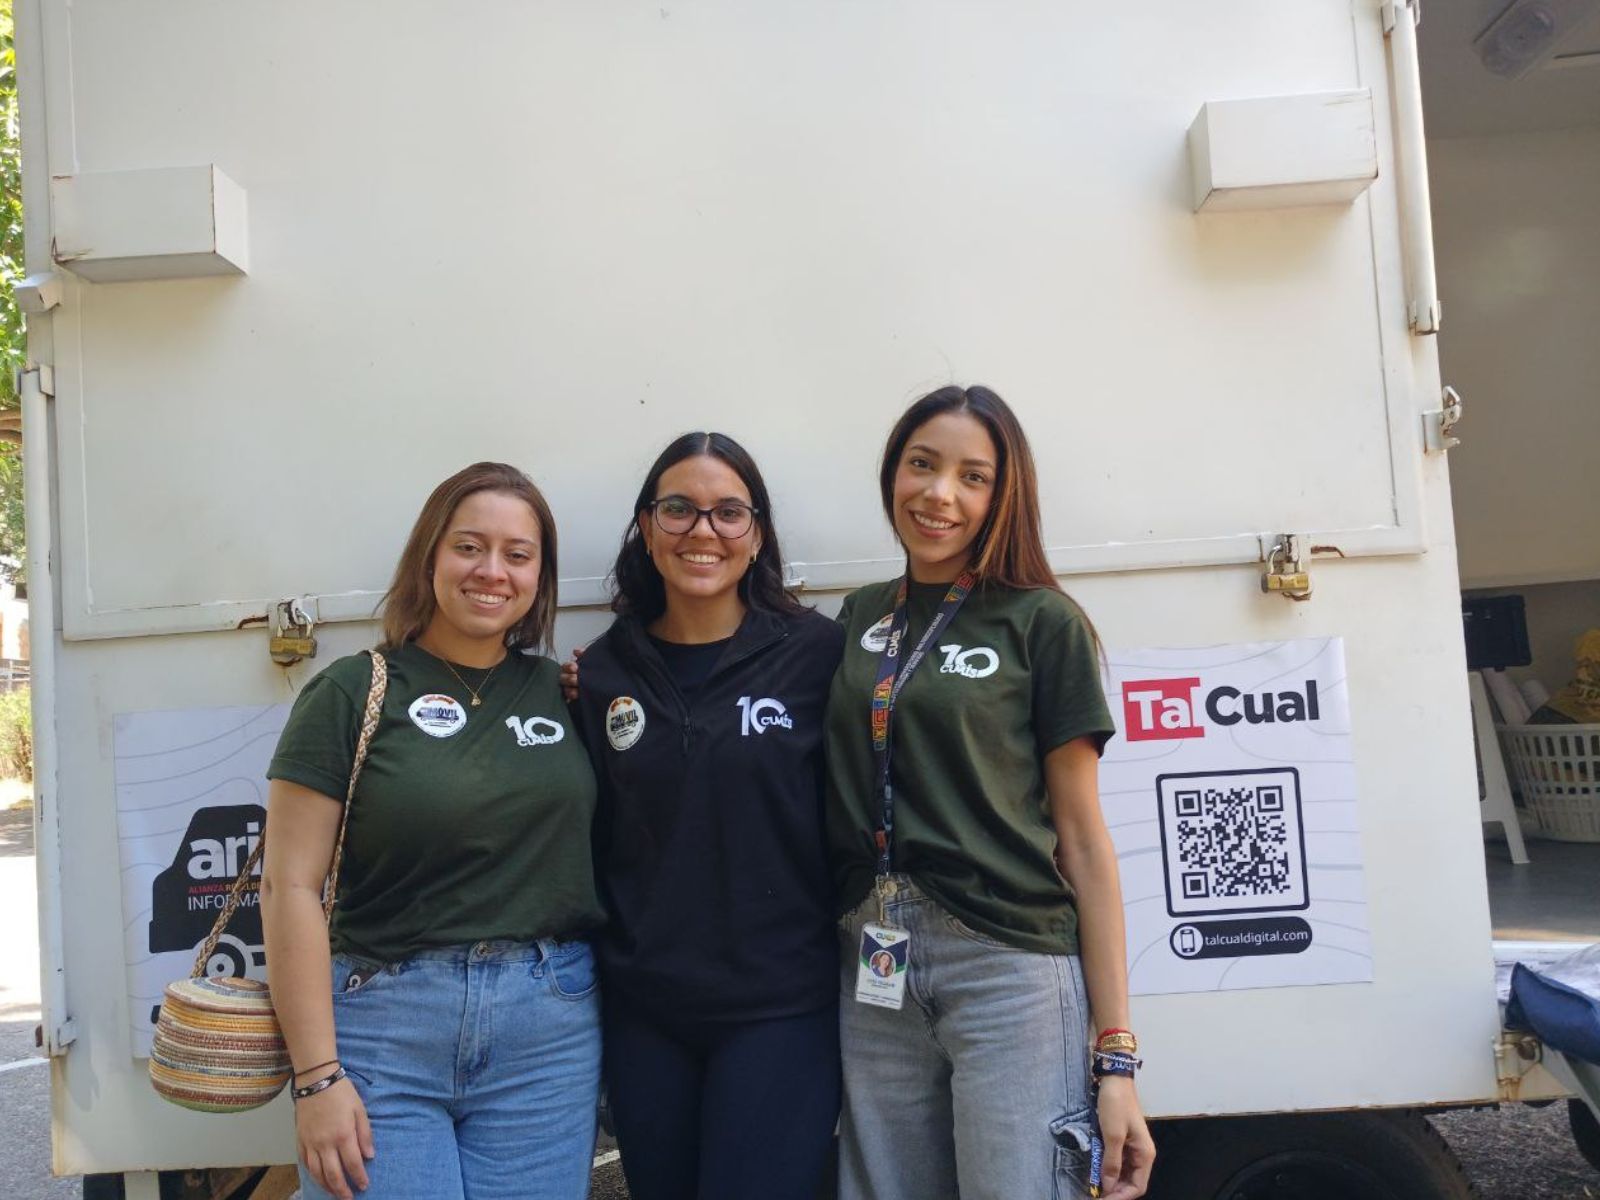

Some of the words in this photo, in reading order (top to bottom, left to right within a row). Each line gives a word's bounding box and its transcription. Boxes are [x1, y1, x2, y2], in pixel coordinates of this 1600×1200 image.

[940, 644, 999, 679] 10
[736, 696, 786, 736] 10
[1127, 686, 1205, 731] Tal
[1205, 680, 1320, 726] Cual
[505, 715, 565, 743] 10
[187, 821, 262, 880] ari
[188, 883, 225, 894] ALIANZA
[1204, 930, 1309, 946] talcualdigital.com
